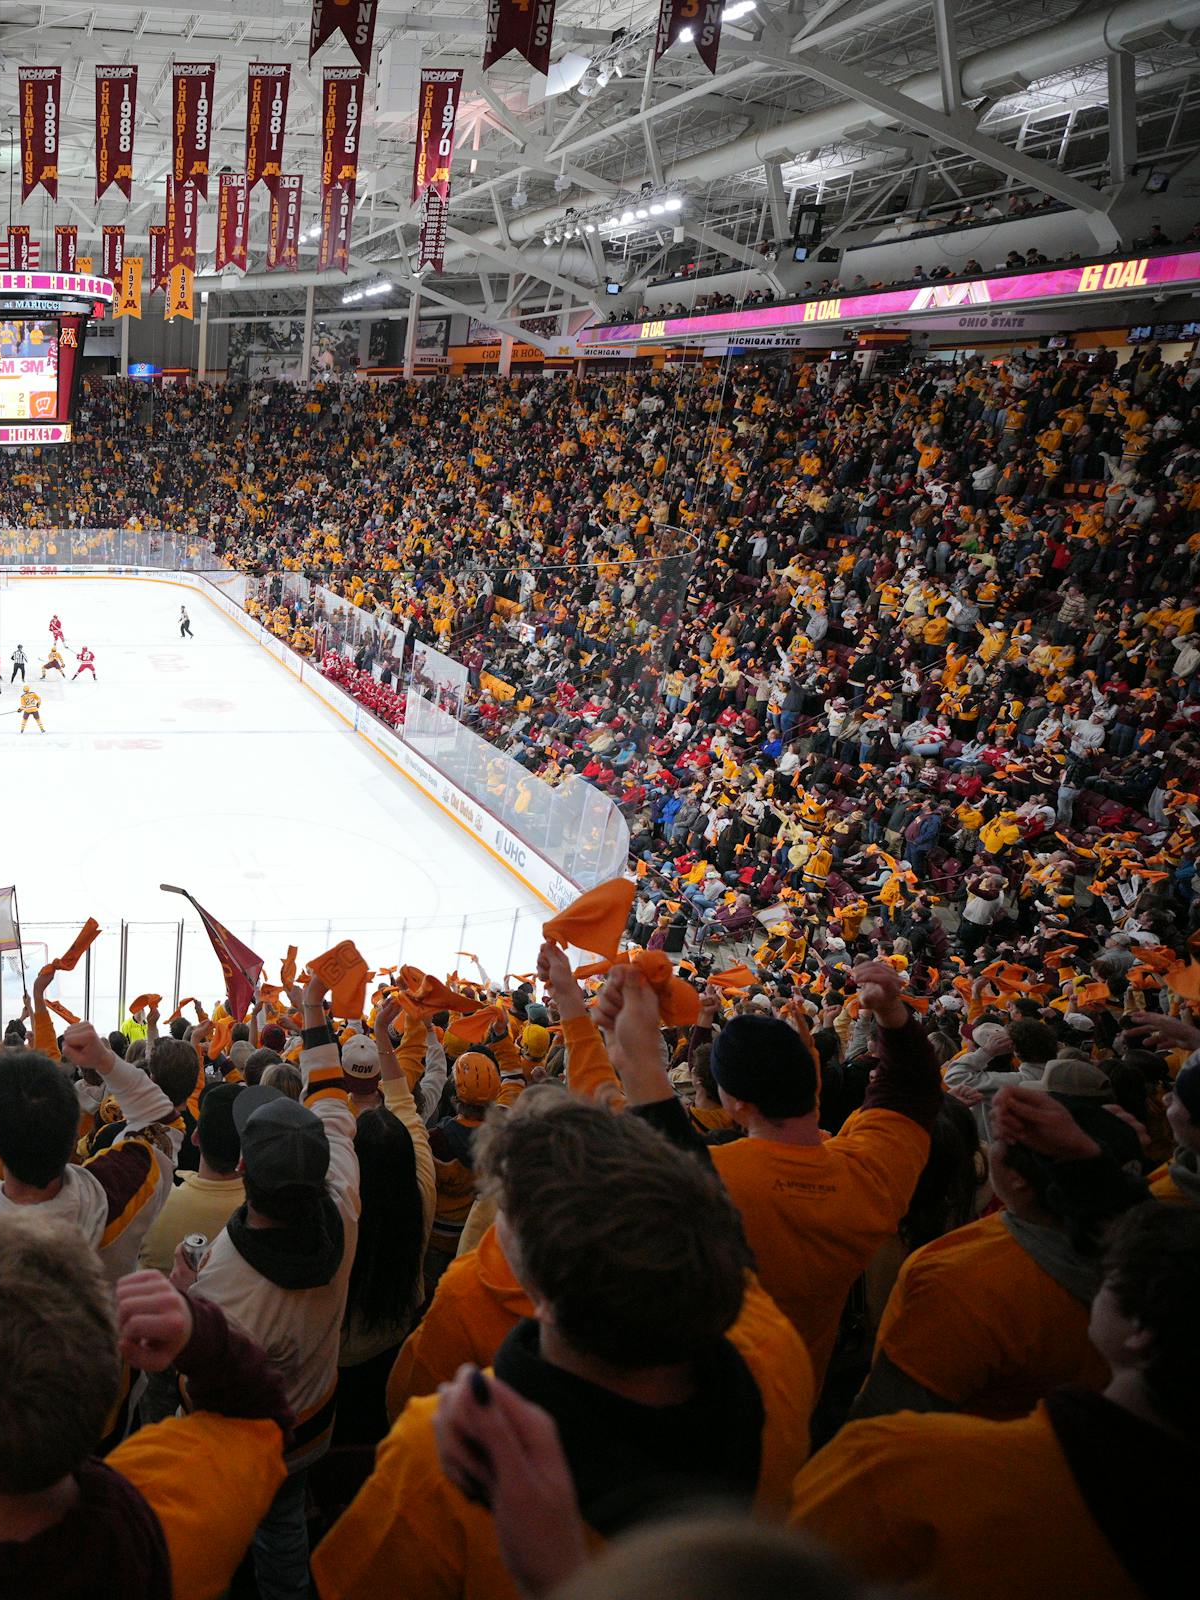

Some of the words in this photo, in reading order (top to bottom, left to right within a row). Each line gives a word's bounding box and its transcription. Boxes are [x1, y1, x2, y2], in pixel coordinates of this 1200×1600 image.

[24, 82, 34, 184] CHAMPIONS
[44, 85, 56, 154] 1989
[100, 81, 110, 182] CHAMPIONS
[119, 83, 132, 153] 1988
[176, 78, 186, 181] CHAMPIONS
[195, 81, 209, 150] 1983
[247, 79, 261, 181] CHAMPIONS
[270, 82, 283, 151] 1981
[323, 82, 337, 184] CHAMPIONS
[344, 85, 357, 154] 1975
[417, 84, 433, 187] CHAMPIONS
[439, 88, 454, 156] 1970
[8, 226, 30, 234] NCAA
[183, 190, 193, 238] 2017
[235, 190, 245, 238] 2016
[286, 190, 298, 239] 2015
[50, 276, 103, 293] HOCKEY
[1077, 259, 1149, 293] GOAL
[640, 321, 666, 338] GOAL
[803, 299, 842, 322] GOAL
[958, 317, 987, 328] OHIO
[990, 317, 1024, 328] STATE
[583, 349, 621, 357] MICHIGAN
[727, 338, 773, 346] MICHIGAN
[775, 337, 801, 346] STATE
[20, 361, 44, 372] 3M
[19, 393, 24, 402] 2
[9, 429, 53, 441] HOCKEY
[20, 566, 36, 575] 3M
[40, 566, 57, 575] 3M
[503, 837, 526, 868] UHC
